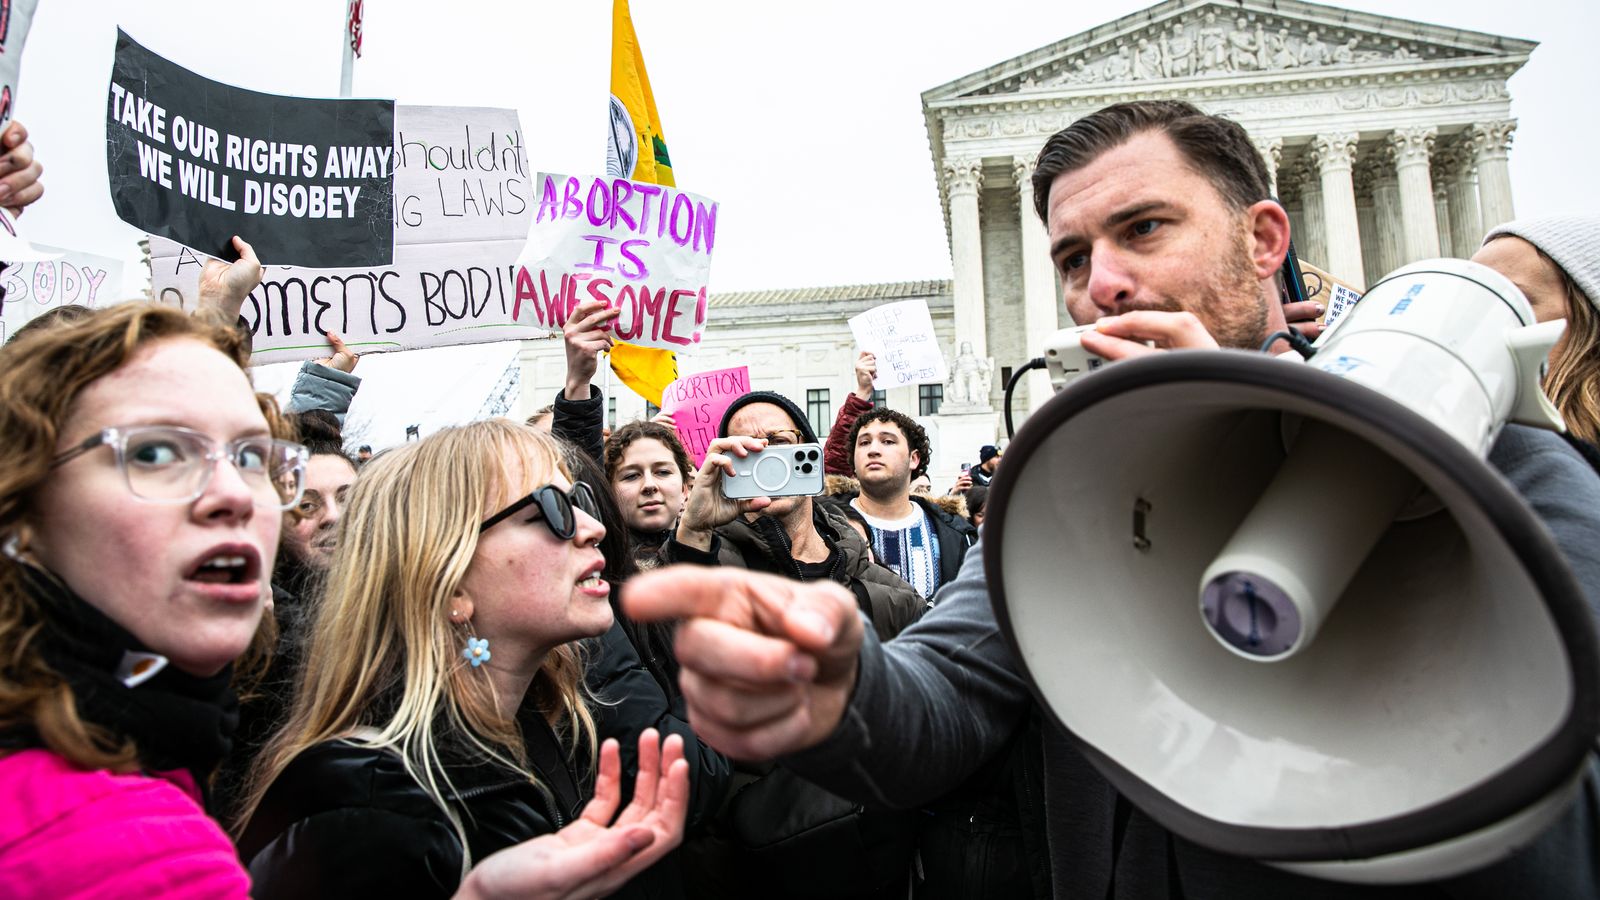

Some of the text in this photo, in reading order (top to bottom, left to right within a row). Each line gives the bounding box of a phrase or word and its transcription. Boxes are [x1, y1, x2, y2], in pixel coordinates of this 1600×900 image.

[111, 81, 392, 179] TAKE OUR RIGHTS AWAY
[137, 139, 361, 219] WE WILL DISOBEY
[437, 177, 526, 217] LAWS
[536, 175, 718, 255] ABORTION
[574, 234, 651, 281] IS
[0, 260, 107, 307] BODY
[1335, 294, 1345, 303] WE
[1337, 286, 1346, 296] WE
[512, 265, 707, 346] AWESOME!
[1333, 301, 1343, 311] WE
[892, 360, 910, 371] HER
[663, 370, 745, 404] ABORTION
[694, 403, 711, 424] IS
